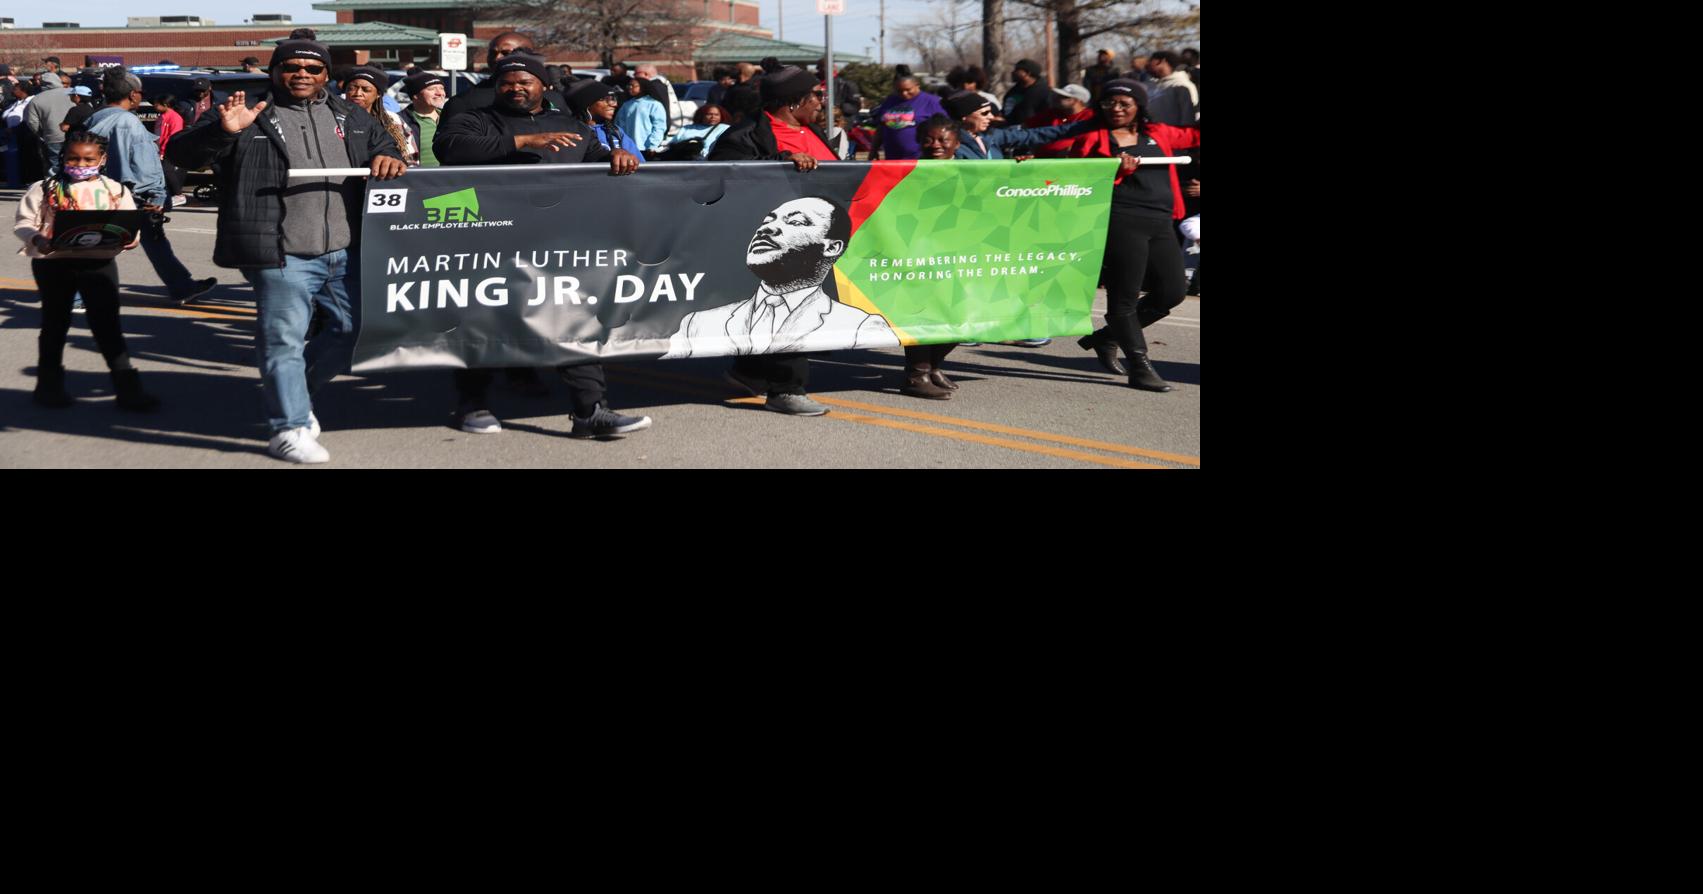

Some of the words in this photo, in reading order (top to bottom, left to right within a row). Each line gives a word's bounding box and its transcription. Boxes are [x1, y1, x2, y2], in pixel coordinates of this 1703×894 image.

[995, 184, 1093, 199] ConocoPhillips
[371, 194, 402, 207] 38
[424, 206, 482, 223] BEN
[389, 223, 420, 231] BLACK
[421, 221, 469, 230] EMPLOYEE
[470, 219, 514, 229] NETWORK
[387, 252, 501, 275] MARTIN
[515, 249, 628, 268] LUTHER
[869, 254, 978, 268] REMEMBERING
[985, 253, 1011, 263] THE
[1017, 251, 1083, 262] LEGACY,
[869, 269, 953, 282] HONORING
[957, 267, 983, 278] THE
[990, 265, 1046, 277] DREAM.
[386, 277, 509, 313] KING
[527, 275, 599, 306] JR.
[613, 272, 706, 304] DAY
